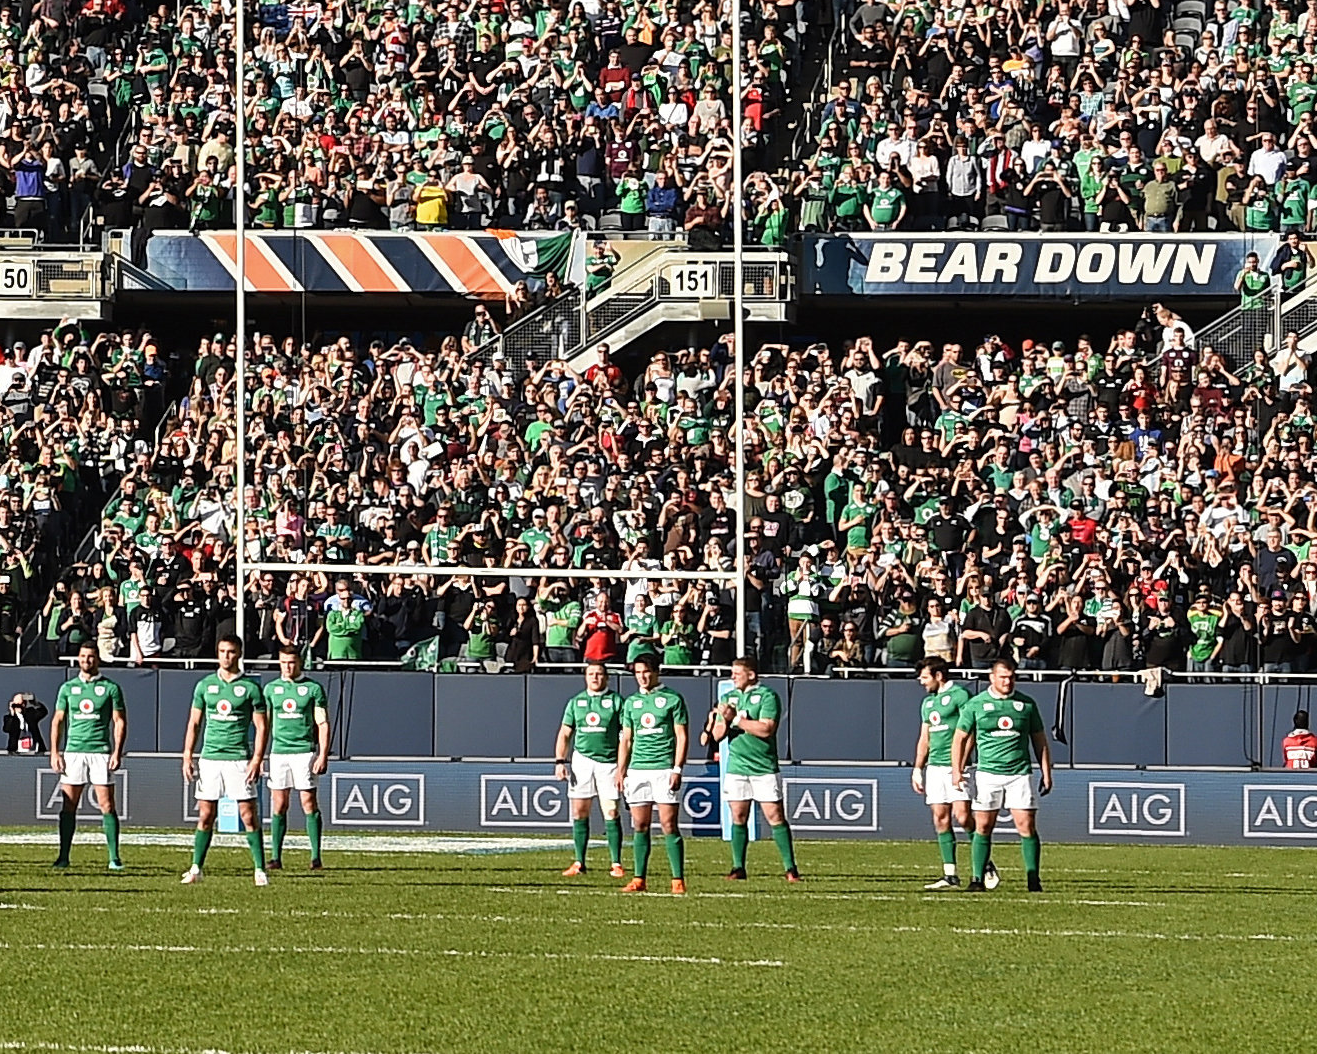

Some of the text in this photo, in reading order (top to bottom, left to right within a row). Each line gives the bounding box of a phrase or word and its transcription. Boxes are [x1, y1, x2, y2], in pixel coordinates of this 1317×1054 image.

[864, 242, 1217, 285] BEAR DOWN
[675, 270, 709, 292] 151
[340, 783, 413, 816] AIG
[490, 784, 563, 817] AIG
[792, 788, 866, 821] AIG
[1098, 793, 1174, 826] AIG
